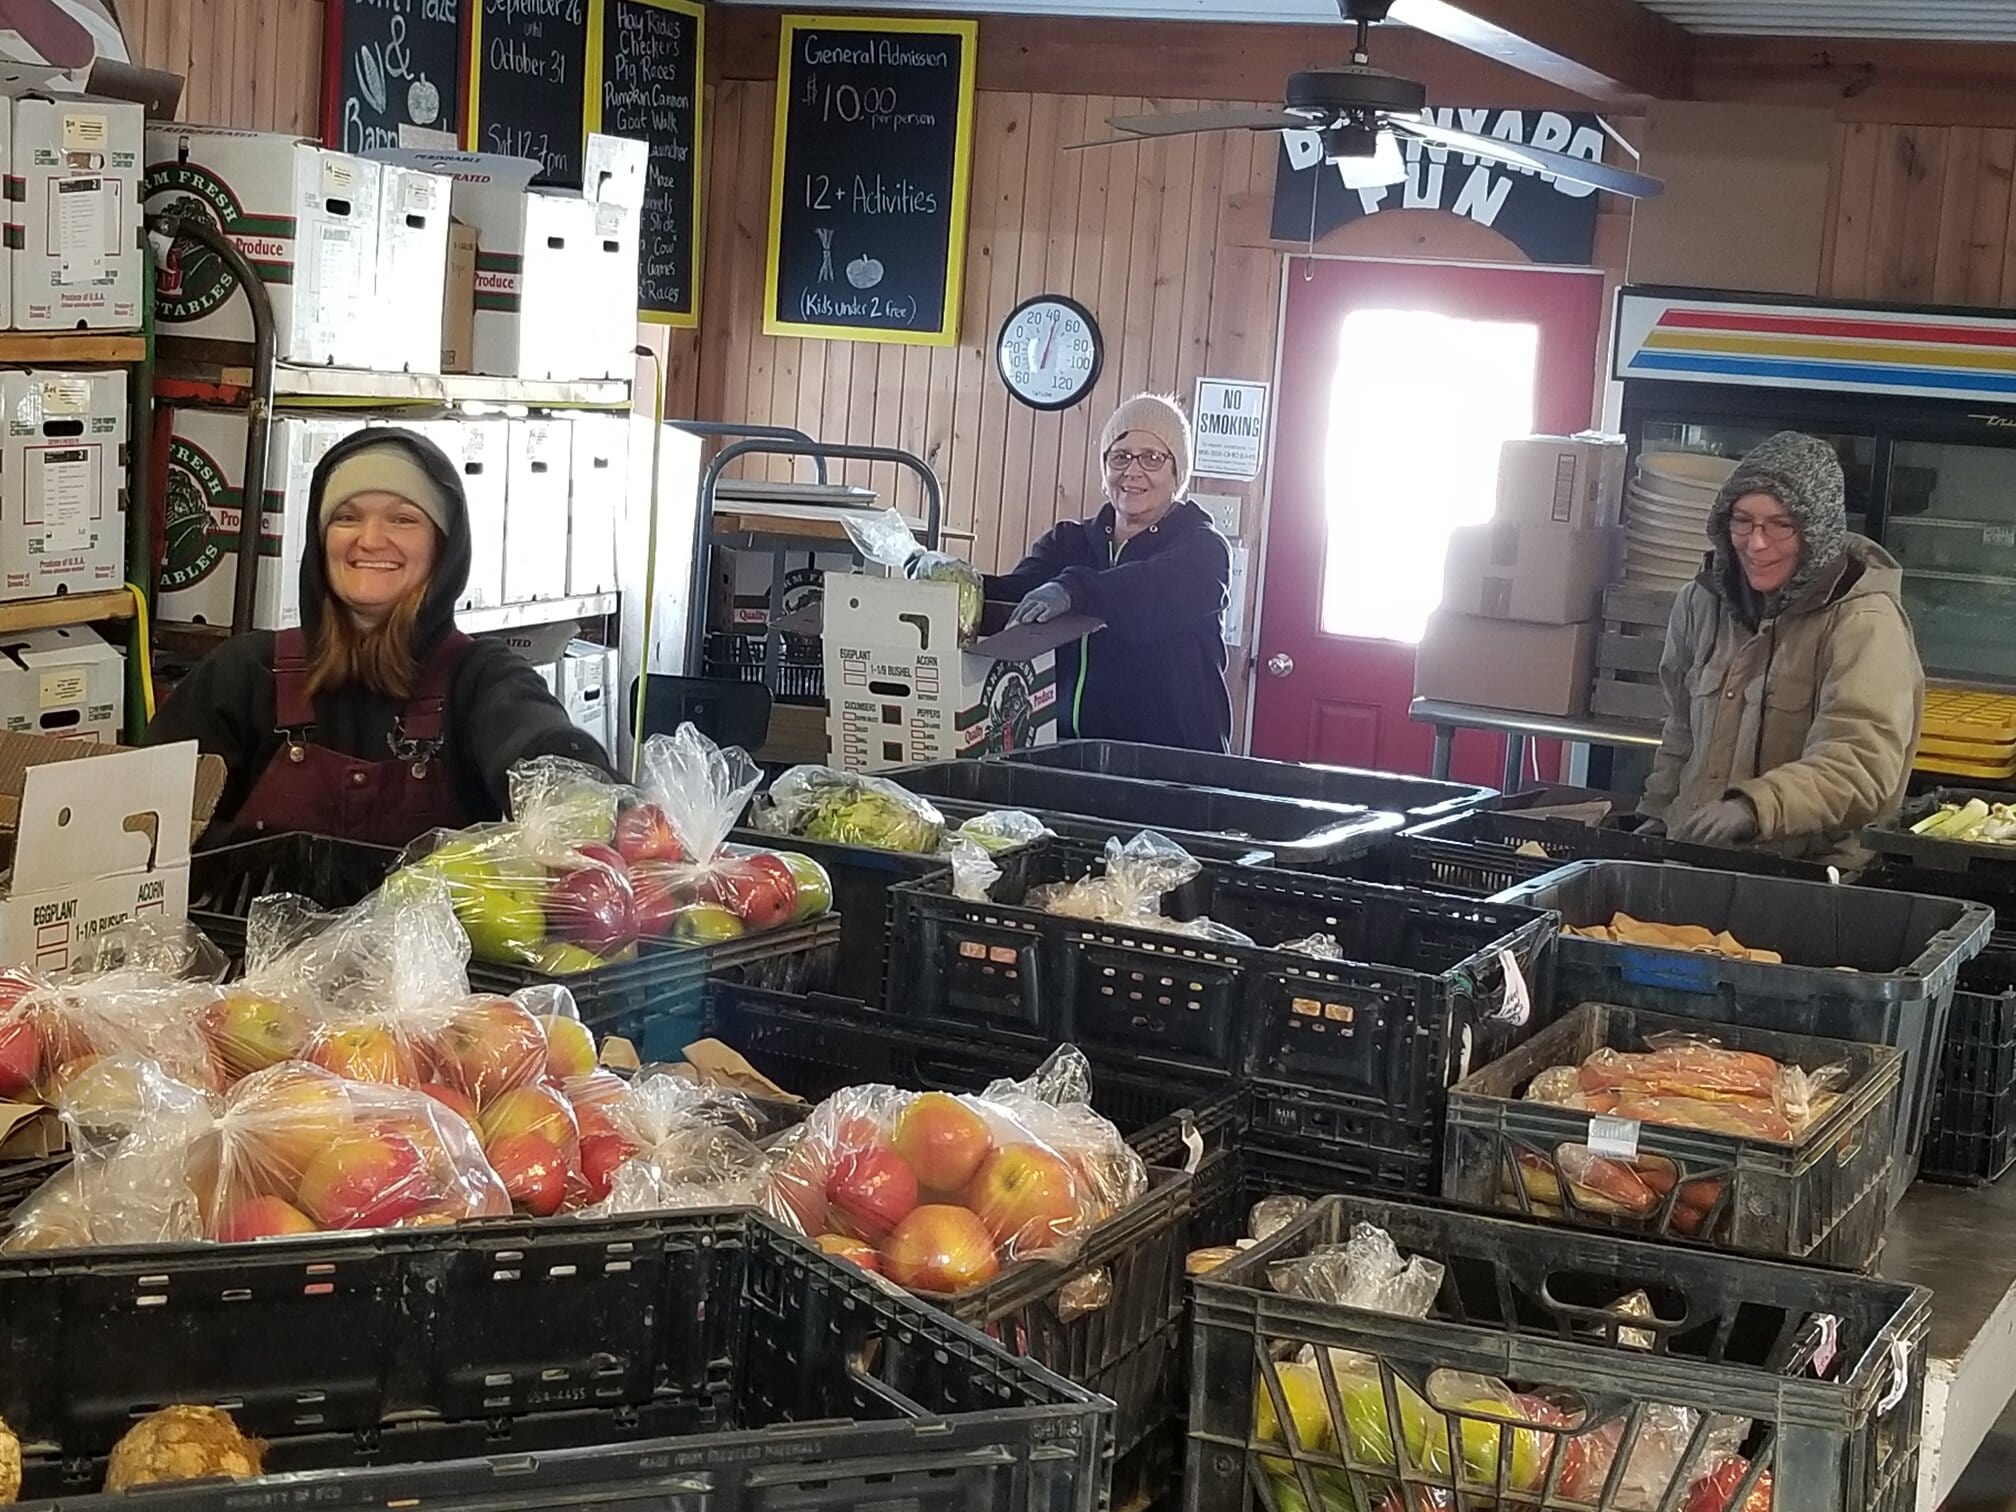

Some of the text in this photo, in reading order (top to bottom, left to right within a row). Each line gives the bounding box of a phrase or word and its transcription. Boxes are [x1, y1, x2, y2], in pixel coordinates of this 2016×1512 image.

[565, 0, 582, 25] 26
[617, 2, 680, 40] Hay Rides
[385, 14, 414, 80] &
[620, 30, 680, 58] Checkers
[805, 34, 948, 68] General Admission
[490, 37, 565, 84] October 31
[615, 53, 676, 90] Pig Races
[604, 81, 689, 109] Pumpkin Cannon
[616, 107, 678, 133] Goat Walk
[872, 112, 936, 132] per person
[488, 123, 512, 156] Sat
[415, 153, 481, 163] PERISHABLE
[1282, 107, 1605, 197] BNYARD
[649, 163, 675, 188] Maze
[179, 170, 238, 223] FRESH
[853, 174, 938, 215] Activities
[236, 238, 284, 257] Produce
[647, 256, 676, 276] Games
[474, 272, 515, 290] Produce
[647, 280, 679, 303] Races
[156, 273, 233, 317] TABLES
[835, 297, 868, 318] under
[870, 297, 883, 319] 2
[1027, 311, 1042, 325] 20
[1046, 309, 1061, 322] 40
[1016, 325, 1024, 338] 0
[1065, 319, 1080, 333] 60
[1073, 339, 1089, 352] 80
[1071, 356, 1091, 371] 100
[1052, 376, 1073, 390] 120
[1223, 389, 1241, 410] NO
[1200, 412, 1260, 438] SMOKING
[1986, 415, 2016, 428] tru
[161, 545, 219, 586] ABLES
[740, 609, 768, 622] Quality
[840, 648, 938, 666] EGGPLANT ACORN
[888, 665, 912, 678] BUSHEL
[916, 708, 941, 719] PEPPERS
[965, 724, 984, 745] Quality
[137, 880, 165, 902] ACORN
[33, 898, 78, 926] EGGPLANT
[75, 919, 97, 941] 1-1/9
